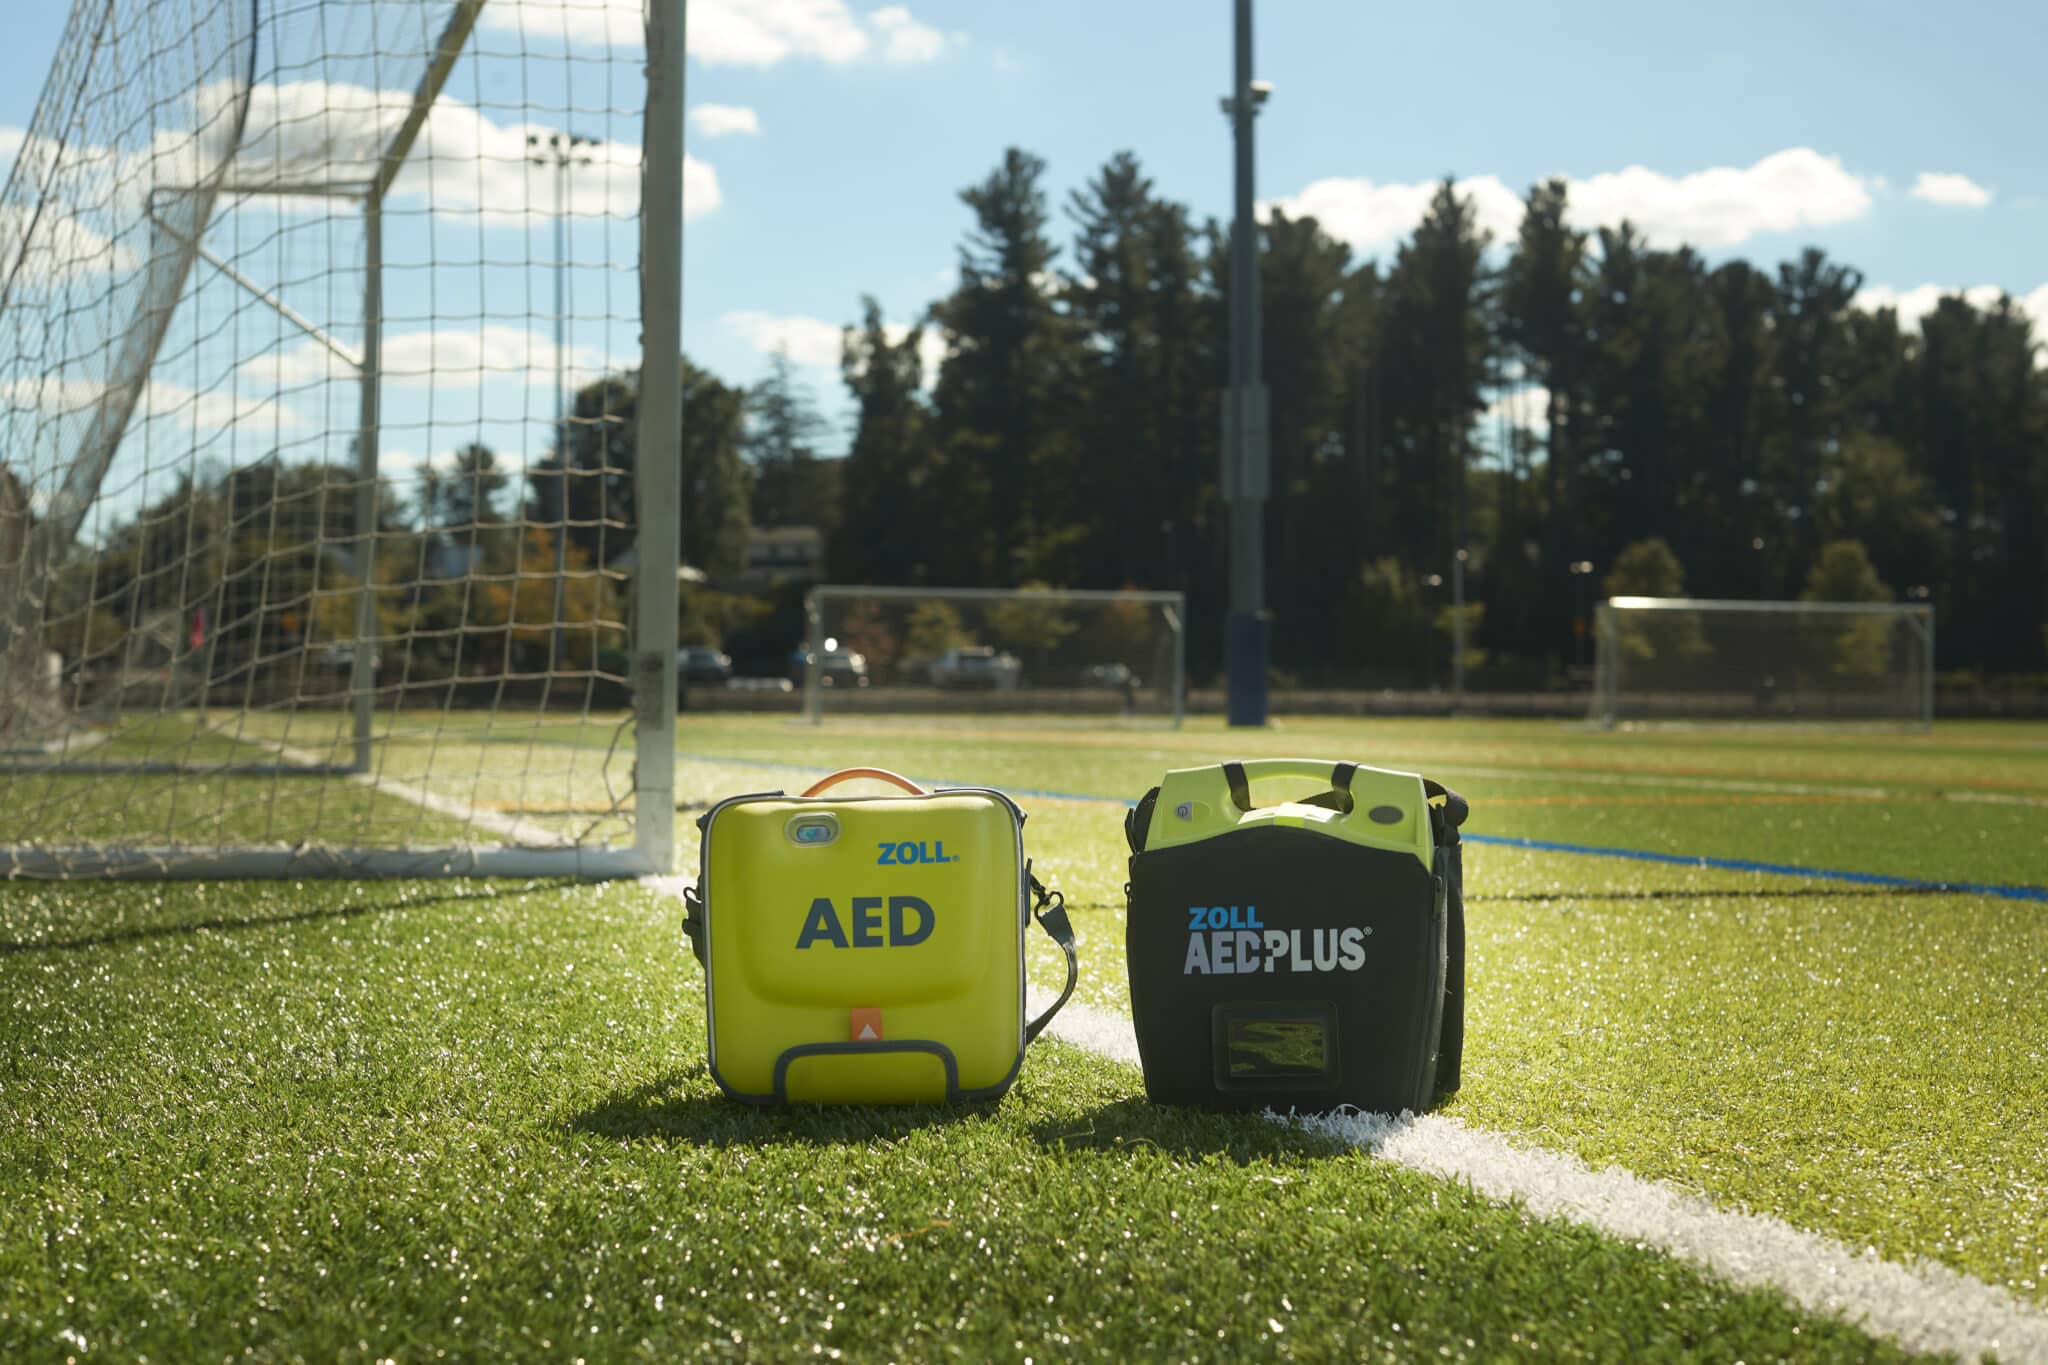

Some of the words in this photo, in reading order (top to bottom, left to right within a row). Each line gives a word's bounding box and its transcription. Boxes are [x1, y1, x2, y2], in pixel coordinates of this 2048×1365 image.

[877, 841, 951, 864] ZOLL
[795, 896, 936, 949] AED
[1188, 906, 1264, 930] ZOLL
